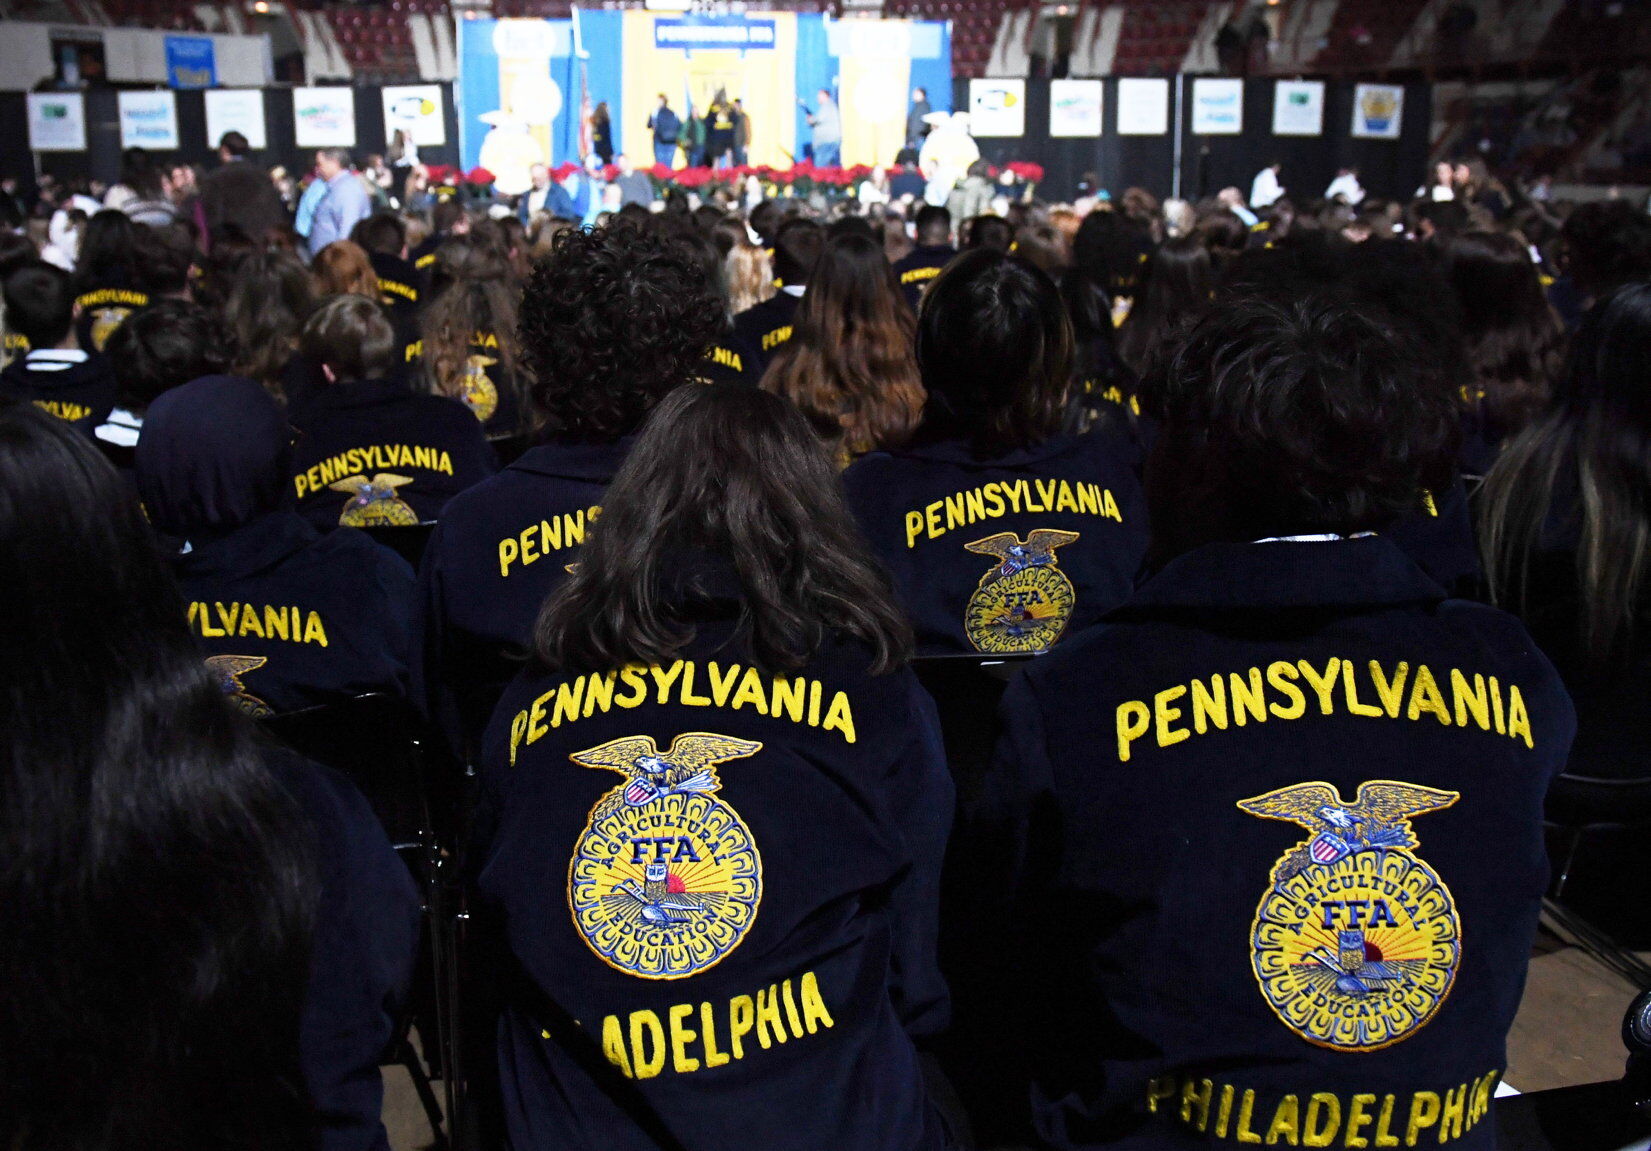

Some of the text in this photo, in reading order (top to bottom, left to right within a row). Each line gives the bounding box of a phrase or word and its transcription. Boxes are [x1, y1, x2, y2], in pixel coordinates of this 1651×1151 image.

[295, 444, 454, 498] PENNSYLVANIA
[905, 478, 1123, 548] PENNSYLVANIA
[1004, 591, 1043, 607] FFA
[510, 659, 856, 766] PENNSYLVANIA
[1116, 657, 1534, 762] PENNSYLVANIA
[600, 814, 728, 870] AGRICULTURAL
[630, 836, 699, 864] FFA
[610, 909, 719, 946] EDUCATION
[1287, 874, 1428, 935] AGRICULTURAL
[1321, 899, 1398, 929] FFA
[1301, 978, 1418, 1018] EDUCATION
